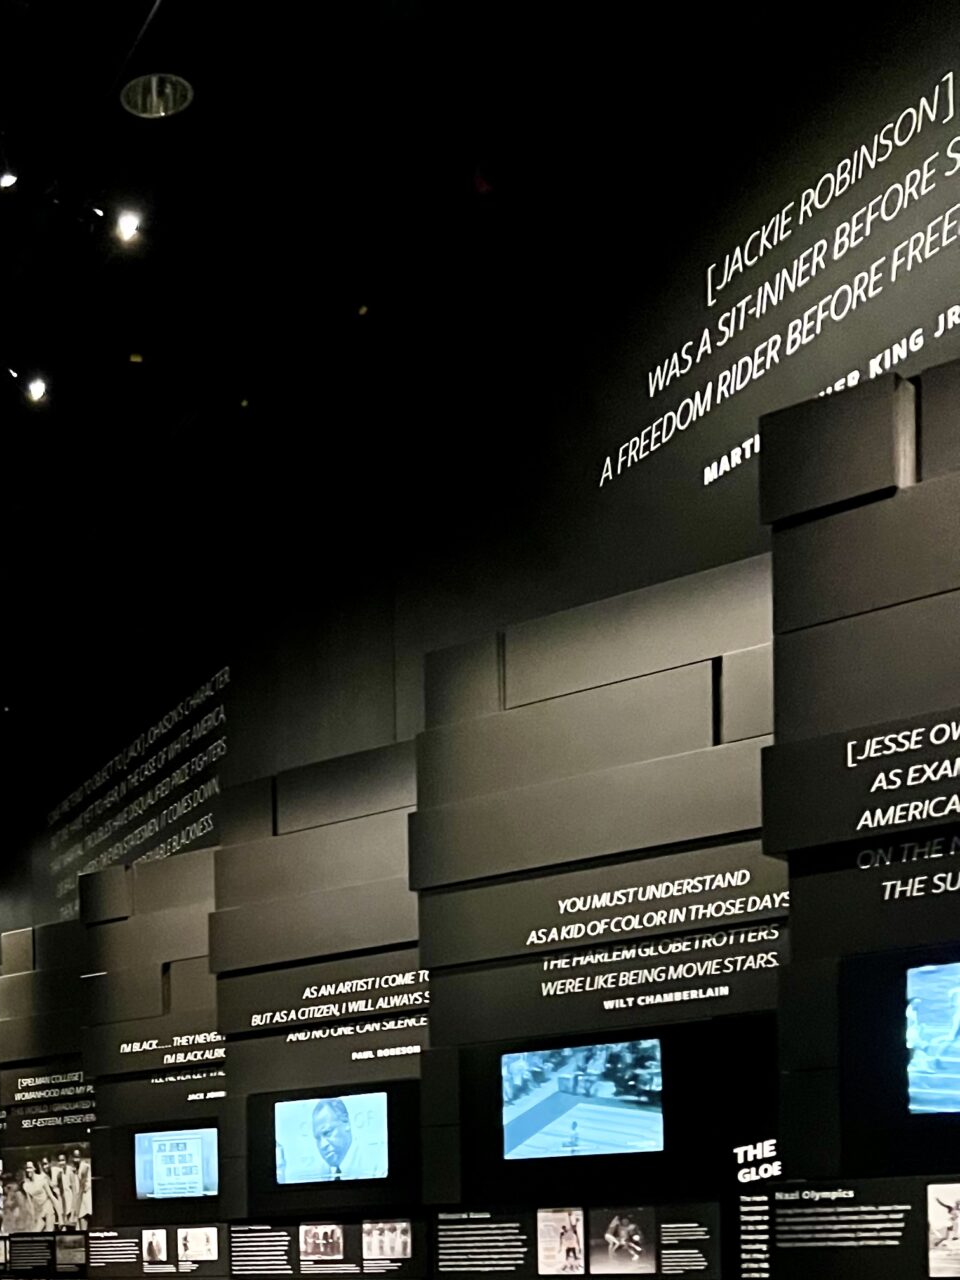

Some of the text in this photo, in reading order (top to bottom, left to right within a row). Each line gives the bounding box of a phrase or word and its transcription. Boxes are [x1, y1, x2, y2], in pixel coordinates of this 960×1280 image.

[707, 71, 954, 307] [JACKIE ROBINSON]
[649, 341, 694, 398] WAS
[696, 328, 712, 363] A
[716, 239, 828, 347] SIT-INNER
[833, 152, 939, 261] BEFORE
[869, 327, 924, 380] KING
[600, 457, 613, 487] A
[617, 381, 713, 475] FREEDOM
[716, 334, 782, 404] RIDER
[786, 256, 887, 356] BEFORE
[847, 728, 925, 767] [JESSE
[870, 768, 903, 793] AS
[558, 869, 751, 914] YOU MUST UNDERSTAND
[882, 876, 928, 900] THE
[526, 891, 789, 945] AS A KID OF COLOR IN THOSE DAYS
[543, 924, 779, 971] THE HARLEM GLOBETROTTERS
[302, 986, 318, 999] AS
[318, 984, 336, 997] AN
[336, 977, 375, 994] ARTIST
[380, 971, 416, 988] COME
[541, 977, 584, 996] WERE
[585, 973, 618, 991] LIKE
[618, 966, 666, 986] BEING
[667, 959, 722, 980] MOVIE
[251, 1012, 273, 1026] BUT
[272, 1010, 288, 1023] AS
[288, 1009, 296, 1021] A
[347, 998, 375, 1013] WILL
[375, 991, 423, 1009] ALWAYS
[603, 986, 729, 1010] WILT CHAMBERLAIN
[172, 1035, 195, 1047] THEY
[286, 1029, 311, 1042] AND
[311, 1026, 329, 1039] NO
[176, 1050, 204, 1063] BLACK
[351, 1050, 375, 1060] PAUL
[733, 1139, 777, 1164] THE
[801, 1188, 855, 1201] Olympics
